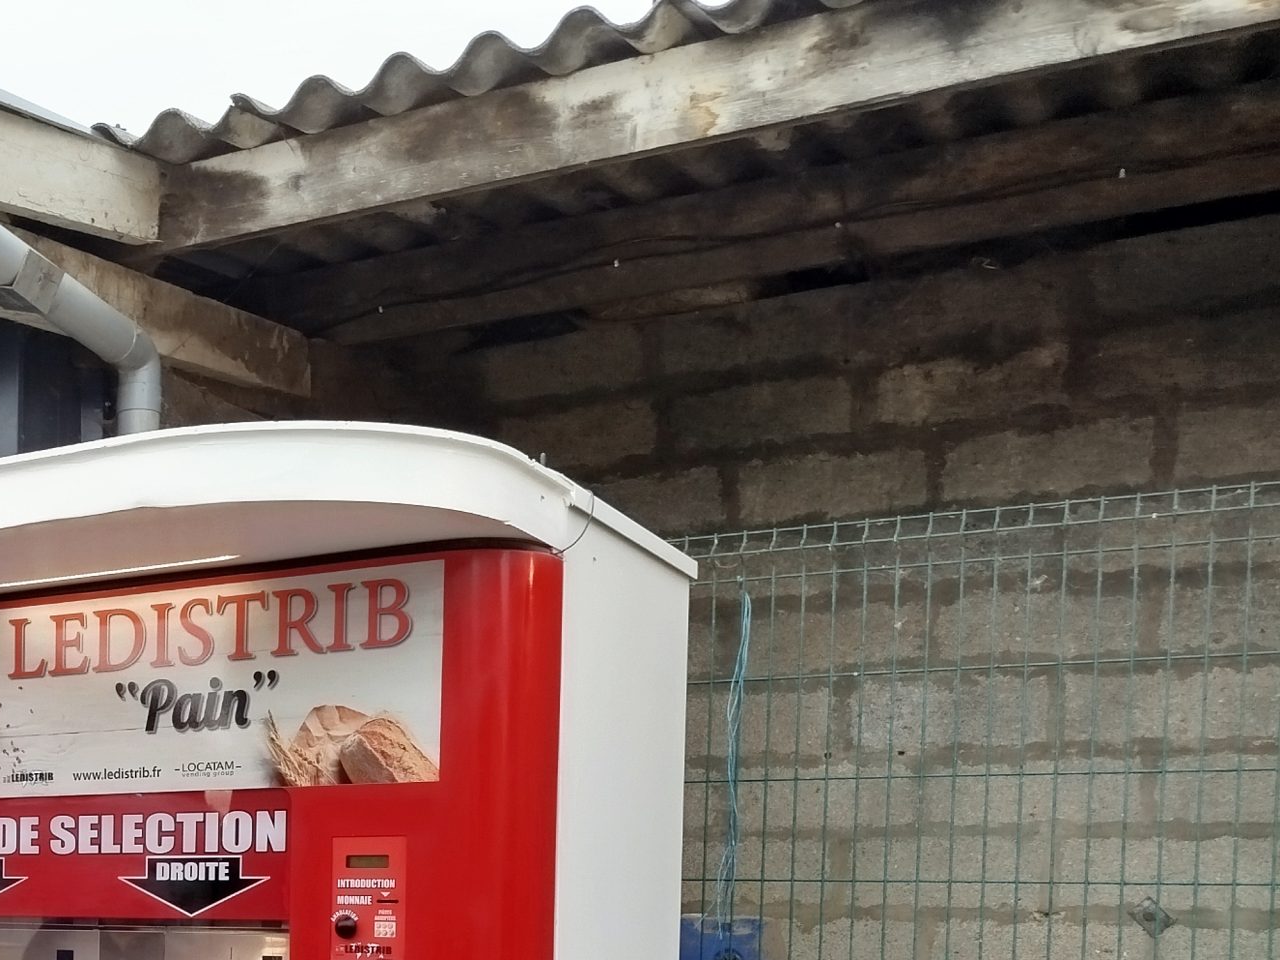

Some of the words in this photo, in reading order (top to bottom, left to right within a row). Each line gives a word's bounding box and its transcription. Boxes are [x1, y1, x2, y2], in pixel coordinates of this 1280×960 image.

[8, 577, 413, 680] LEDISTRIB
[11, 772, 54, 783] LEDISTRIB
[72, 766, 162, 781] www.ledistrib.fr
[213, 770, 234, 778] group
[49, 810, 287, 854] SELECTION
[156, 861, 230, 881] DROITE
[337, 878, 396, 888] INTRODUCTION
[336, 895, 373, 905] MONNAIE
